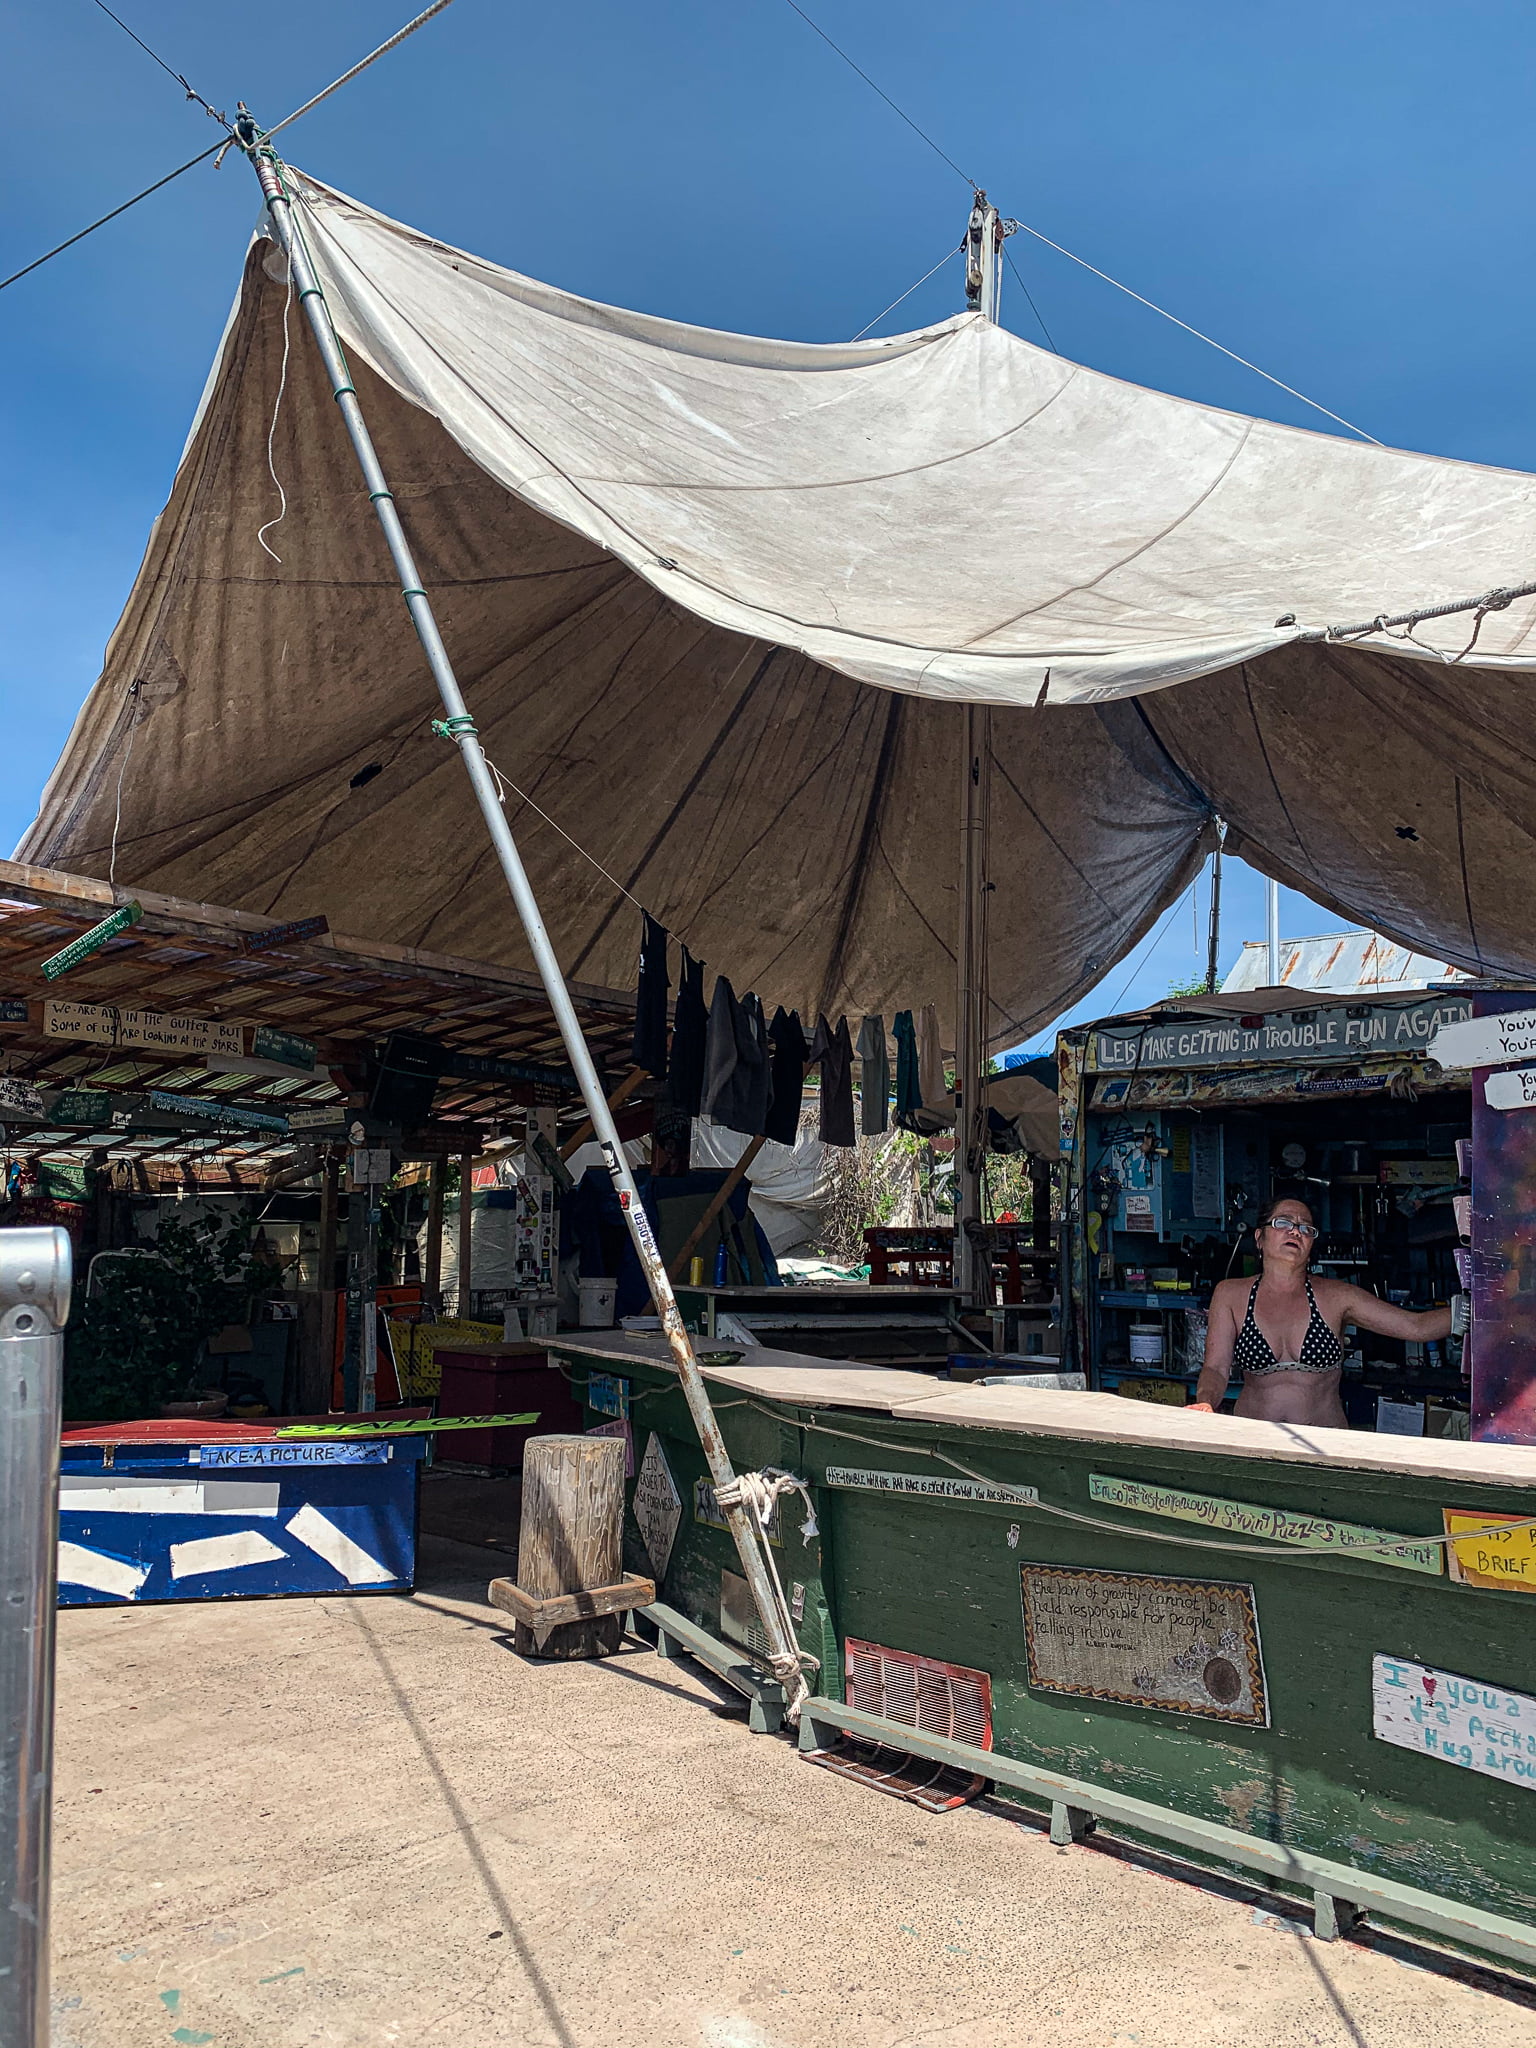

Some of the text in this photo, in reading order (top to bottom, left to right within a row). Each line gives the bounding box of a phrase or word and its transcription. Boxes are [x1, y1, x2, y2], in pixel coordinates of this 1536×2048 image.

[219, 1025, 242, 1038] BUT
[1141, 1035, 1175, 1061] MAKE
[1179, 1029, 1239, 1056] GETTING
[1242, 1031, 1260, 1052] IN
[1263, 1021, 1337, 1049] TROUBLE
[1345, 1016, 1386, 1045] FUN
[1394, 1003, 1473, 1039] AGAIN
[294, 1413, 521, 1432] STAFF ONLY
[1478, 1550, 1531, 1574] BRIEF
[1033, 1581, 1054, 1596] the
[1058, 1582, 1080, 1596] law
[1086, 1585, 1098, 1599] of
[1149, 1591, 1200, 1609] cannot
[1208, 1598, 1227, 1616] be
[1033, 1596, 1216, 1637] held responsible for people
[1034, 1615, 1075, 1646] falling
[1081, 1625, 1094, 1639] in
[1382, 1661, 1409, 1688] I
[1447, 1680, 1499, 1709] you
[1424, 1727, 1473, 1767] Hug
[1469, 1716, 1522, 1750] Peck
